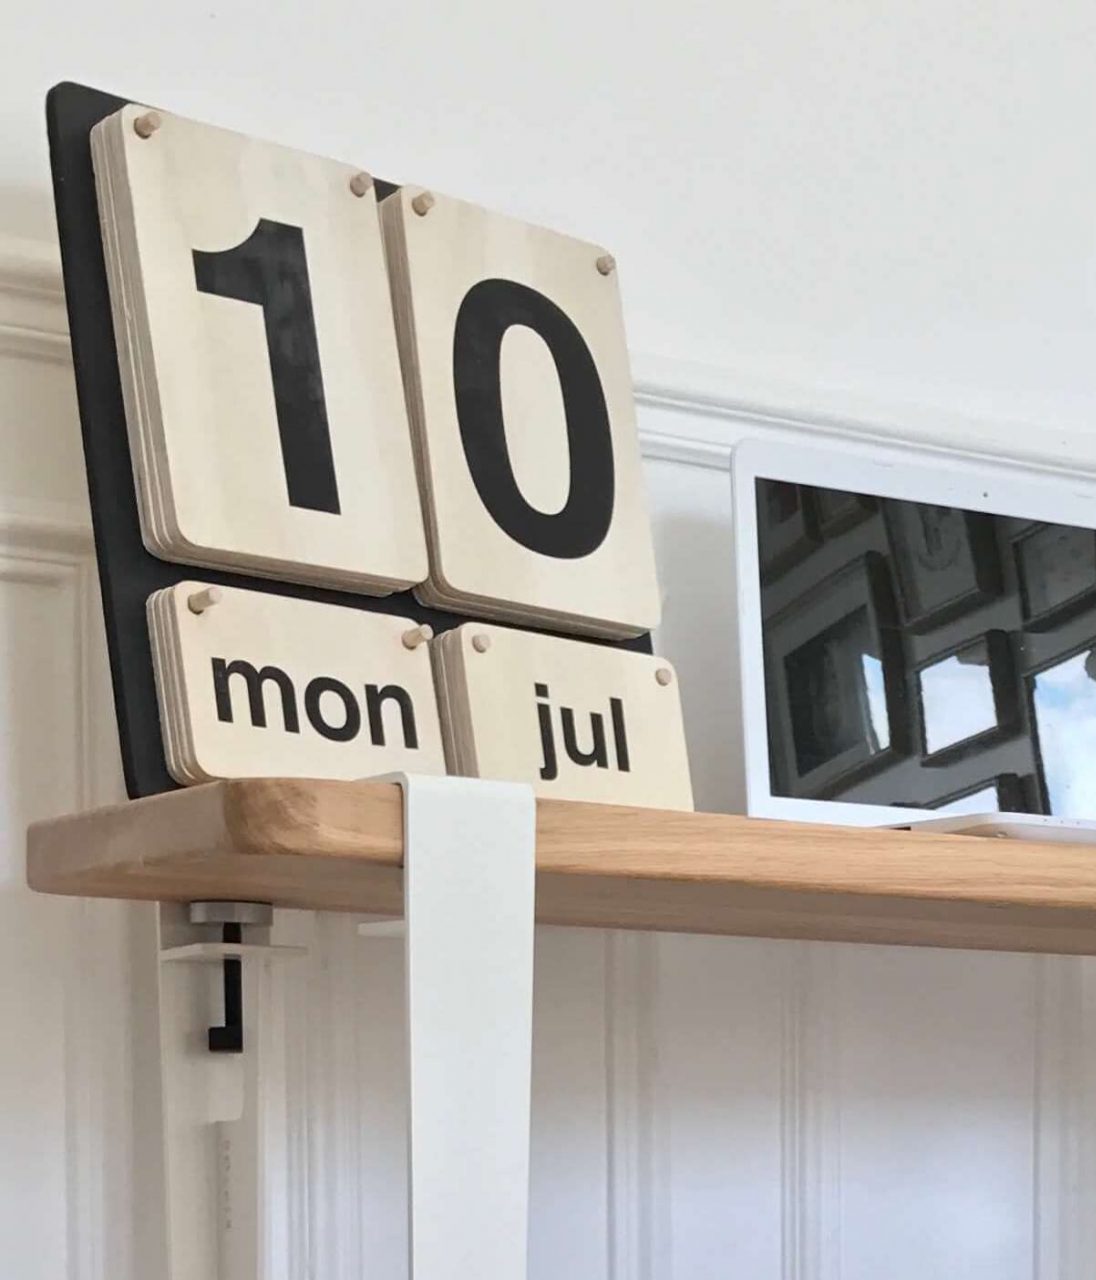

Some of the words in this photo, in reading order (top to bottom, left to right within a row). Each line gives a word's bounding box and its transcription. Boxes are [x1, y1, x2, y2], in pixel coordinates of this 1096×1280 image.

[191, 218, 615, 559] 10
[211, 656, 418, 749] mon
[534, 681, 631, 781] jul
